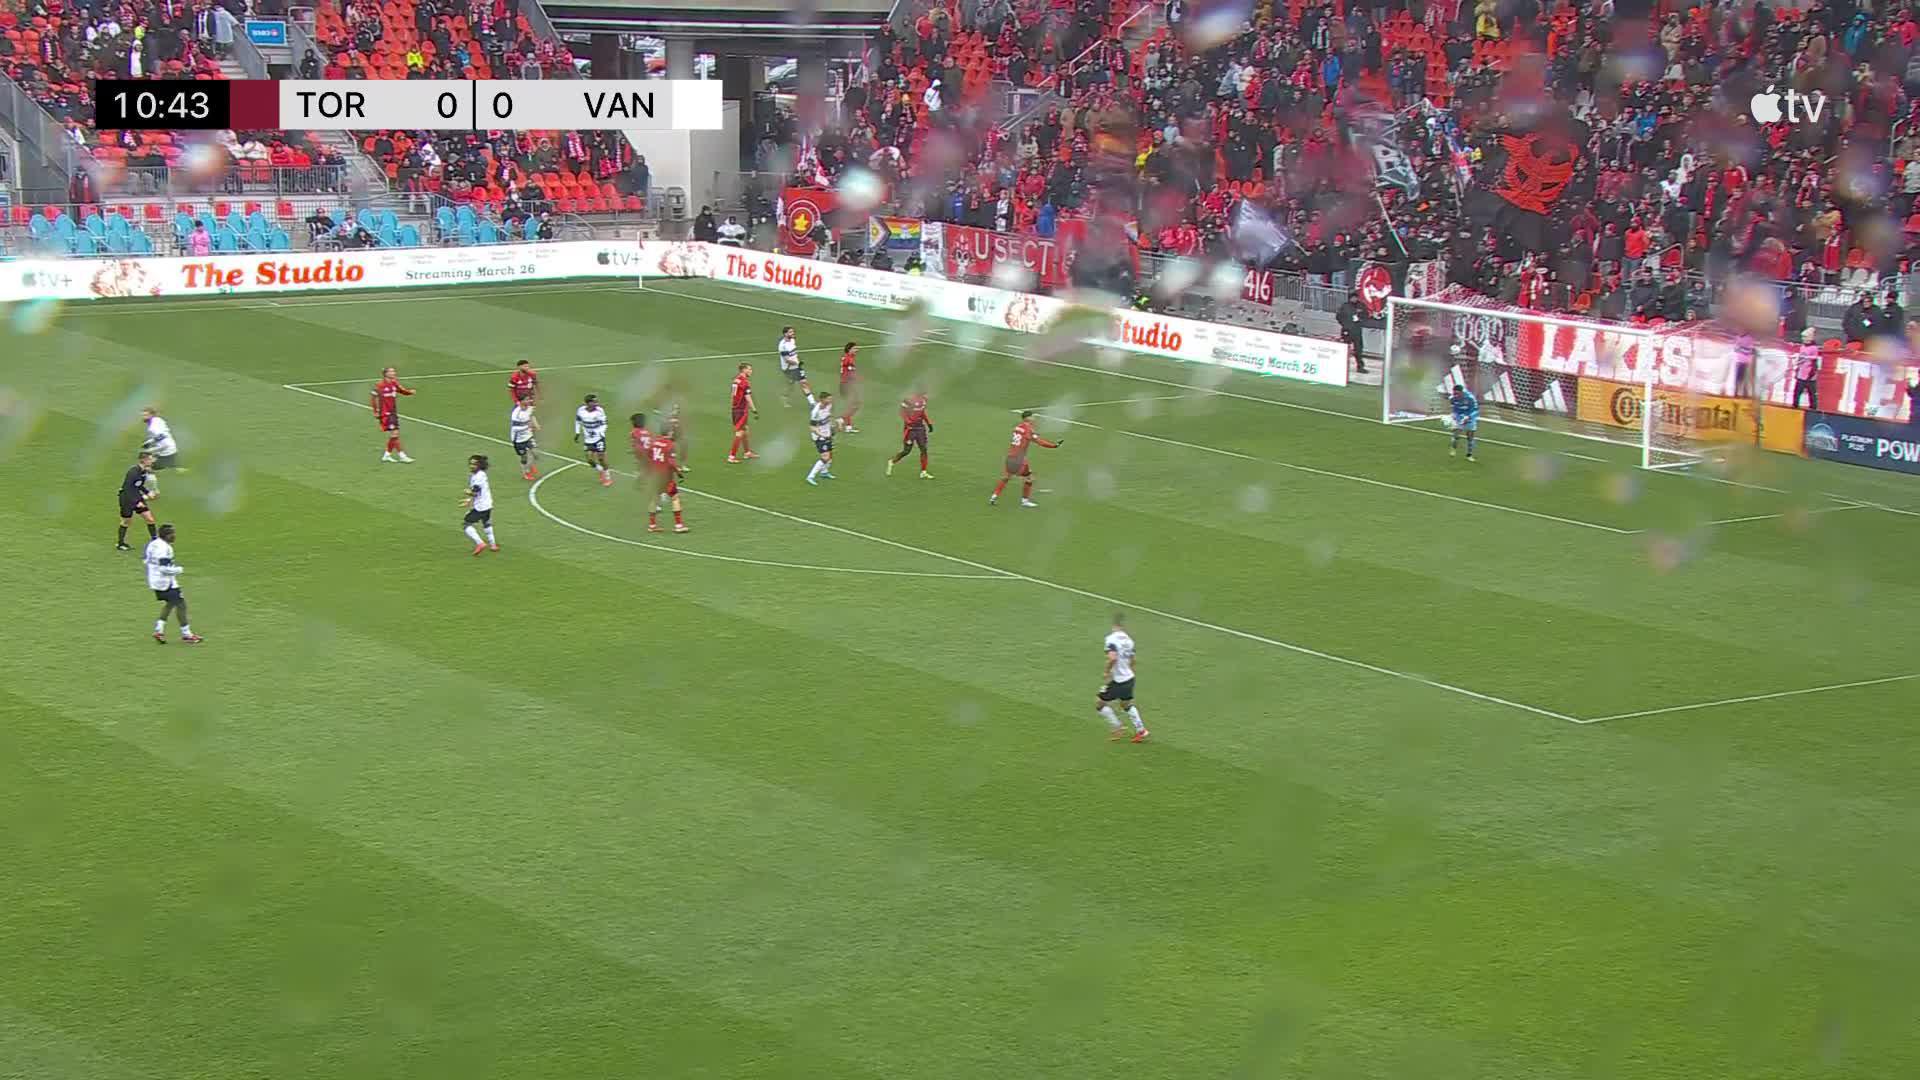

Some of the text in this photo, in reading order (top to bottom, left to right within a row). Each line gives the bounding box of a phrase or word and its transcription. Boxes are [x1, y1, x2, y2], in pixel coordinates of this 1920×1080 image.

[181, 262, 245, 289] The
[255, 258, 366, 286] Studio
[404, 263, 537, 281] Streaming March 26
[726, 253, 824, 291] The Studio
[1243, 268, 1271, 303] 416
